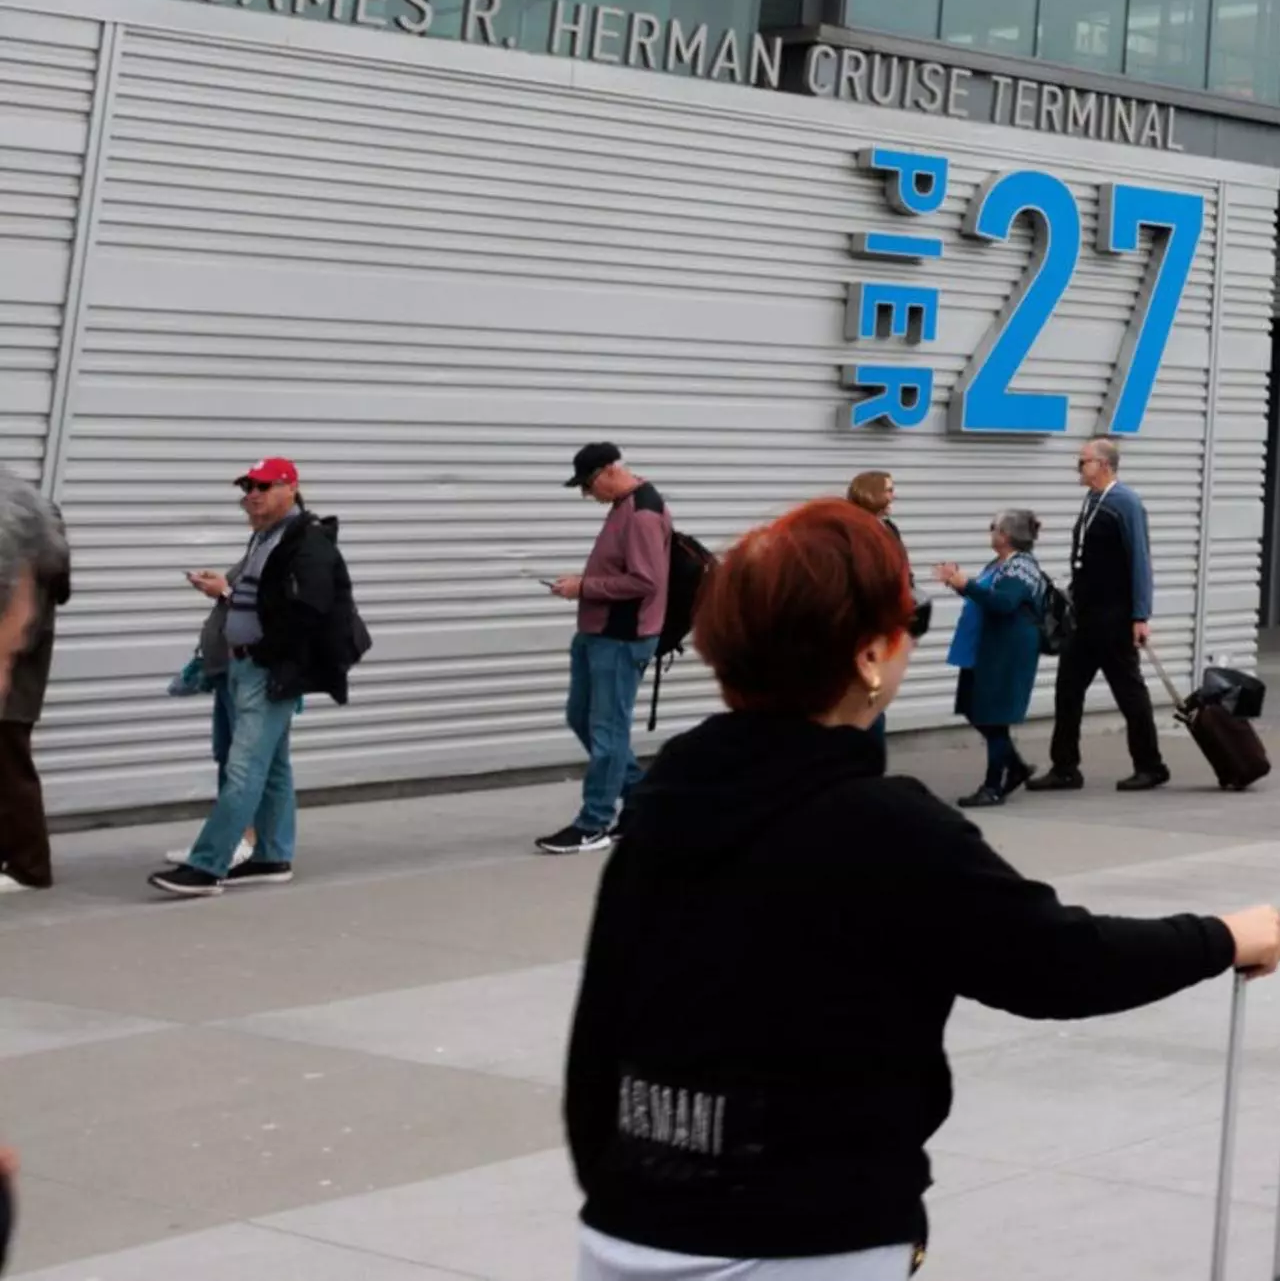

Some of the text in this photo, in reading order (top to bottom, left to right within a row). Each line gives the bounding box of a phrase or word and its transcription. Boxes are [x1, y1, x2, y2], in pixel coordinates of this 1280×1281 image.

[806, 44, 973, 117] CRUISE
[988, 75, 1185, 152] TERMINAL
[848, 146, 950, 429] PIER
[956, 169, 1205, 435] 27
